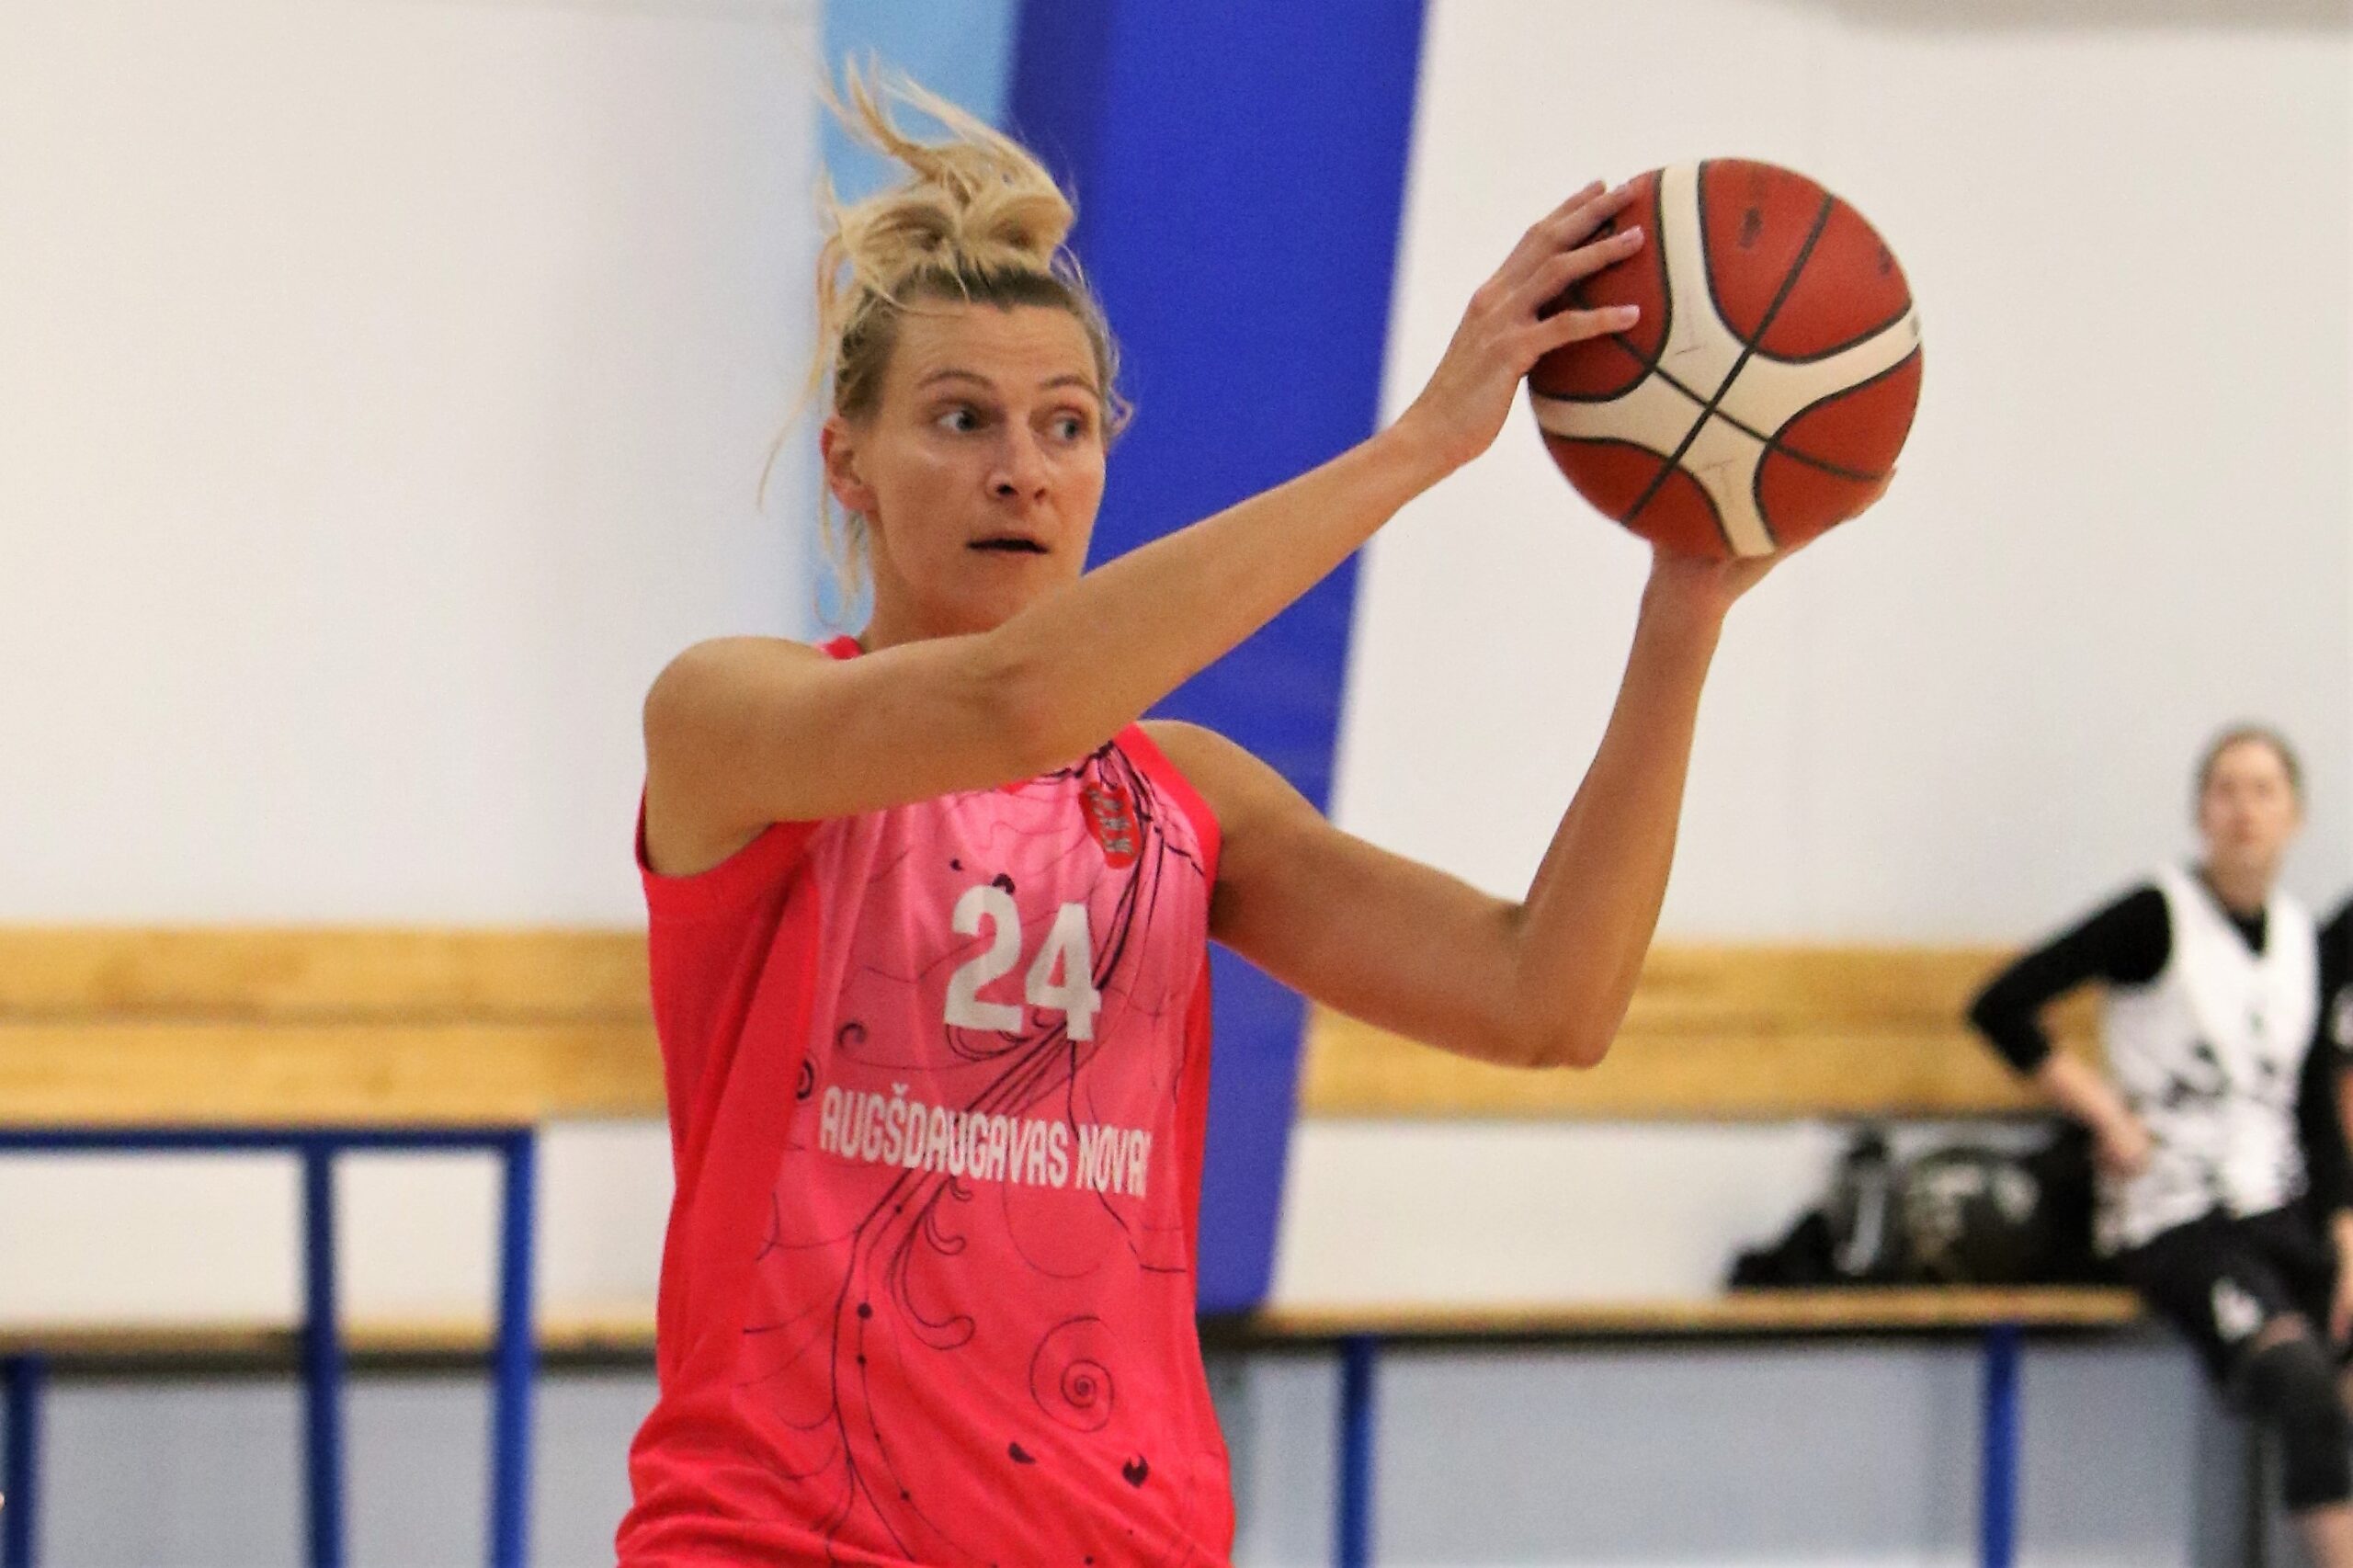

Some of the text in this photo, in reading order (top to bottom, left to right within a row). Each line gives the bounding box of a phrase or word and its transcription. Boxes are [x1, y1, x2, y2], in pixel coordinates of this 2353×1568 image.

[944, 884, 1102, 1040] 24
[819, 1083, 1153, 1199] AUGŠDAUGAVAS NOVA
